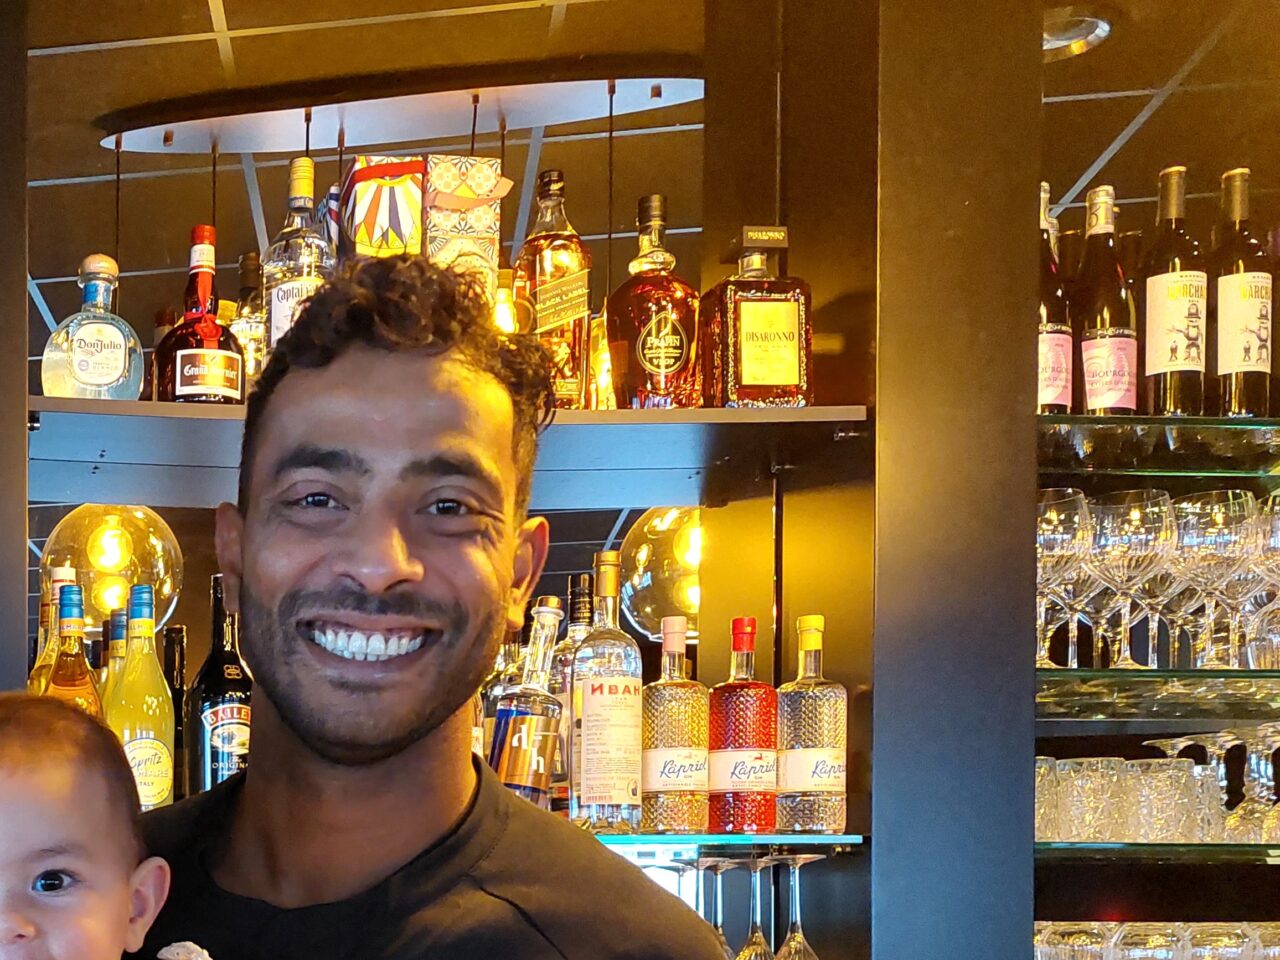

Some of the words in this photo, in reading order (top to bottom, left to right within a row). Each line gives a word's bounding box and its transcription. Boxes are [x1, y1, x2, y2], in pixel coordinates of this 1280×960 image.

[535, 296, 561, 310] BLACK
[562, 287, 587, 301] LABEL
[745, 331, 795, 343] DISARONNO
